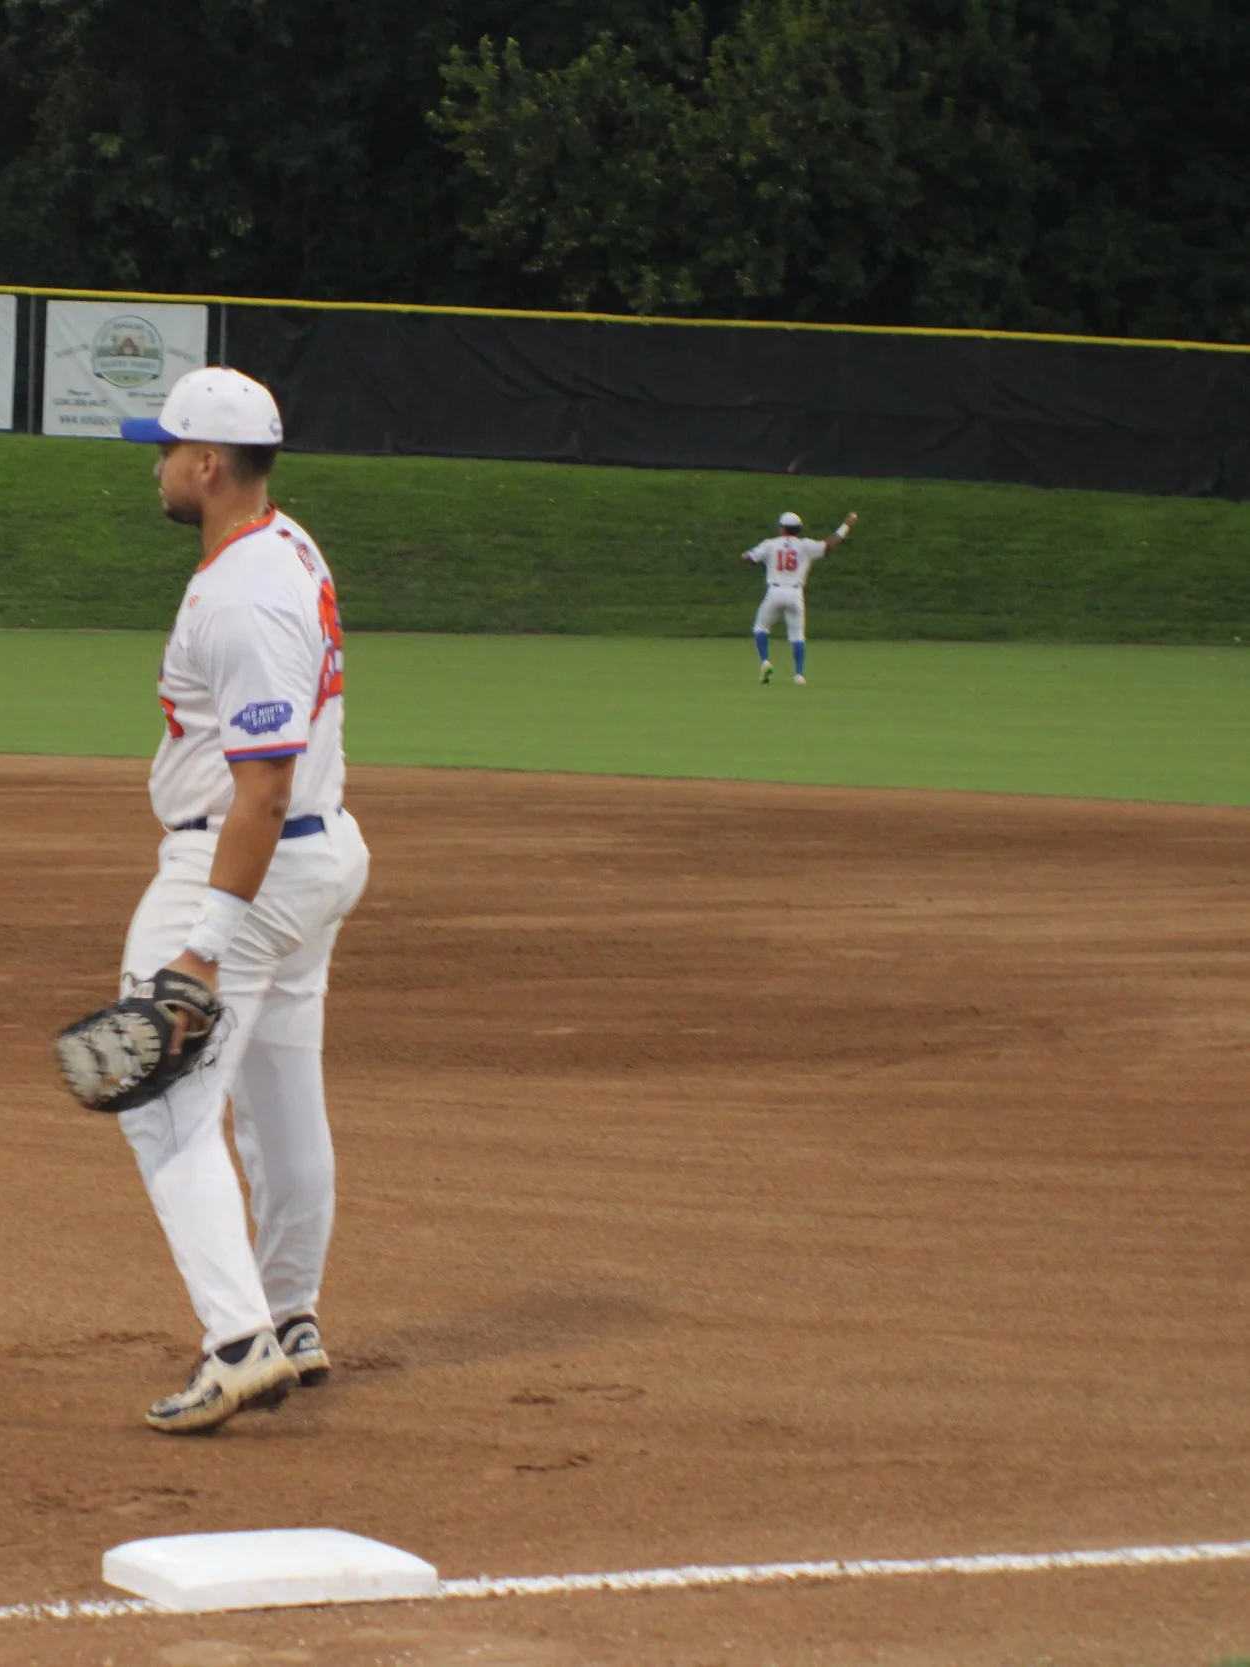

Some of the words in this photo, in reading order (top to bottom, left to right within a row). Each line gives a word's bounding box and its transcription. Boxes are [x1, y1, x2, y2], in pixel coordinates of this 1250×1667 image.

[776, 549, 798, 572] 16
[242, 710, 257, 722] OLD
[258, 703, 285, 718] NORTH
[252, 713, 276, 728] STATE
